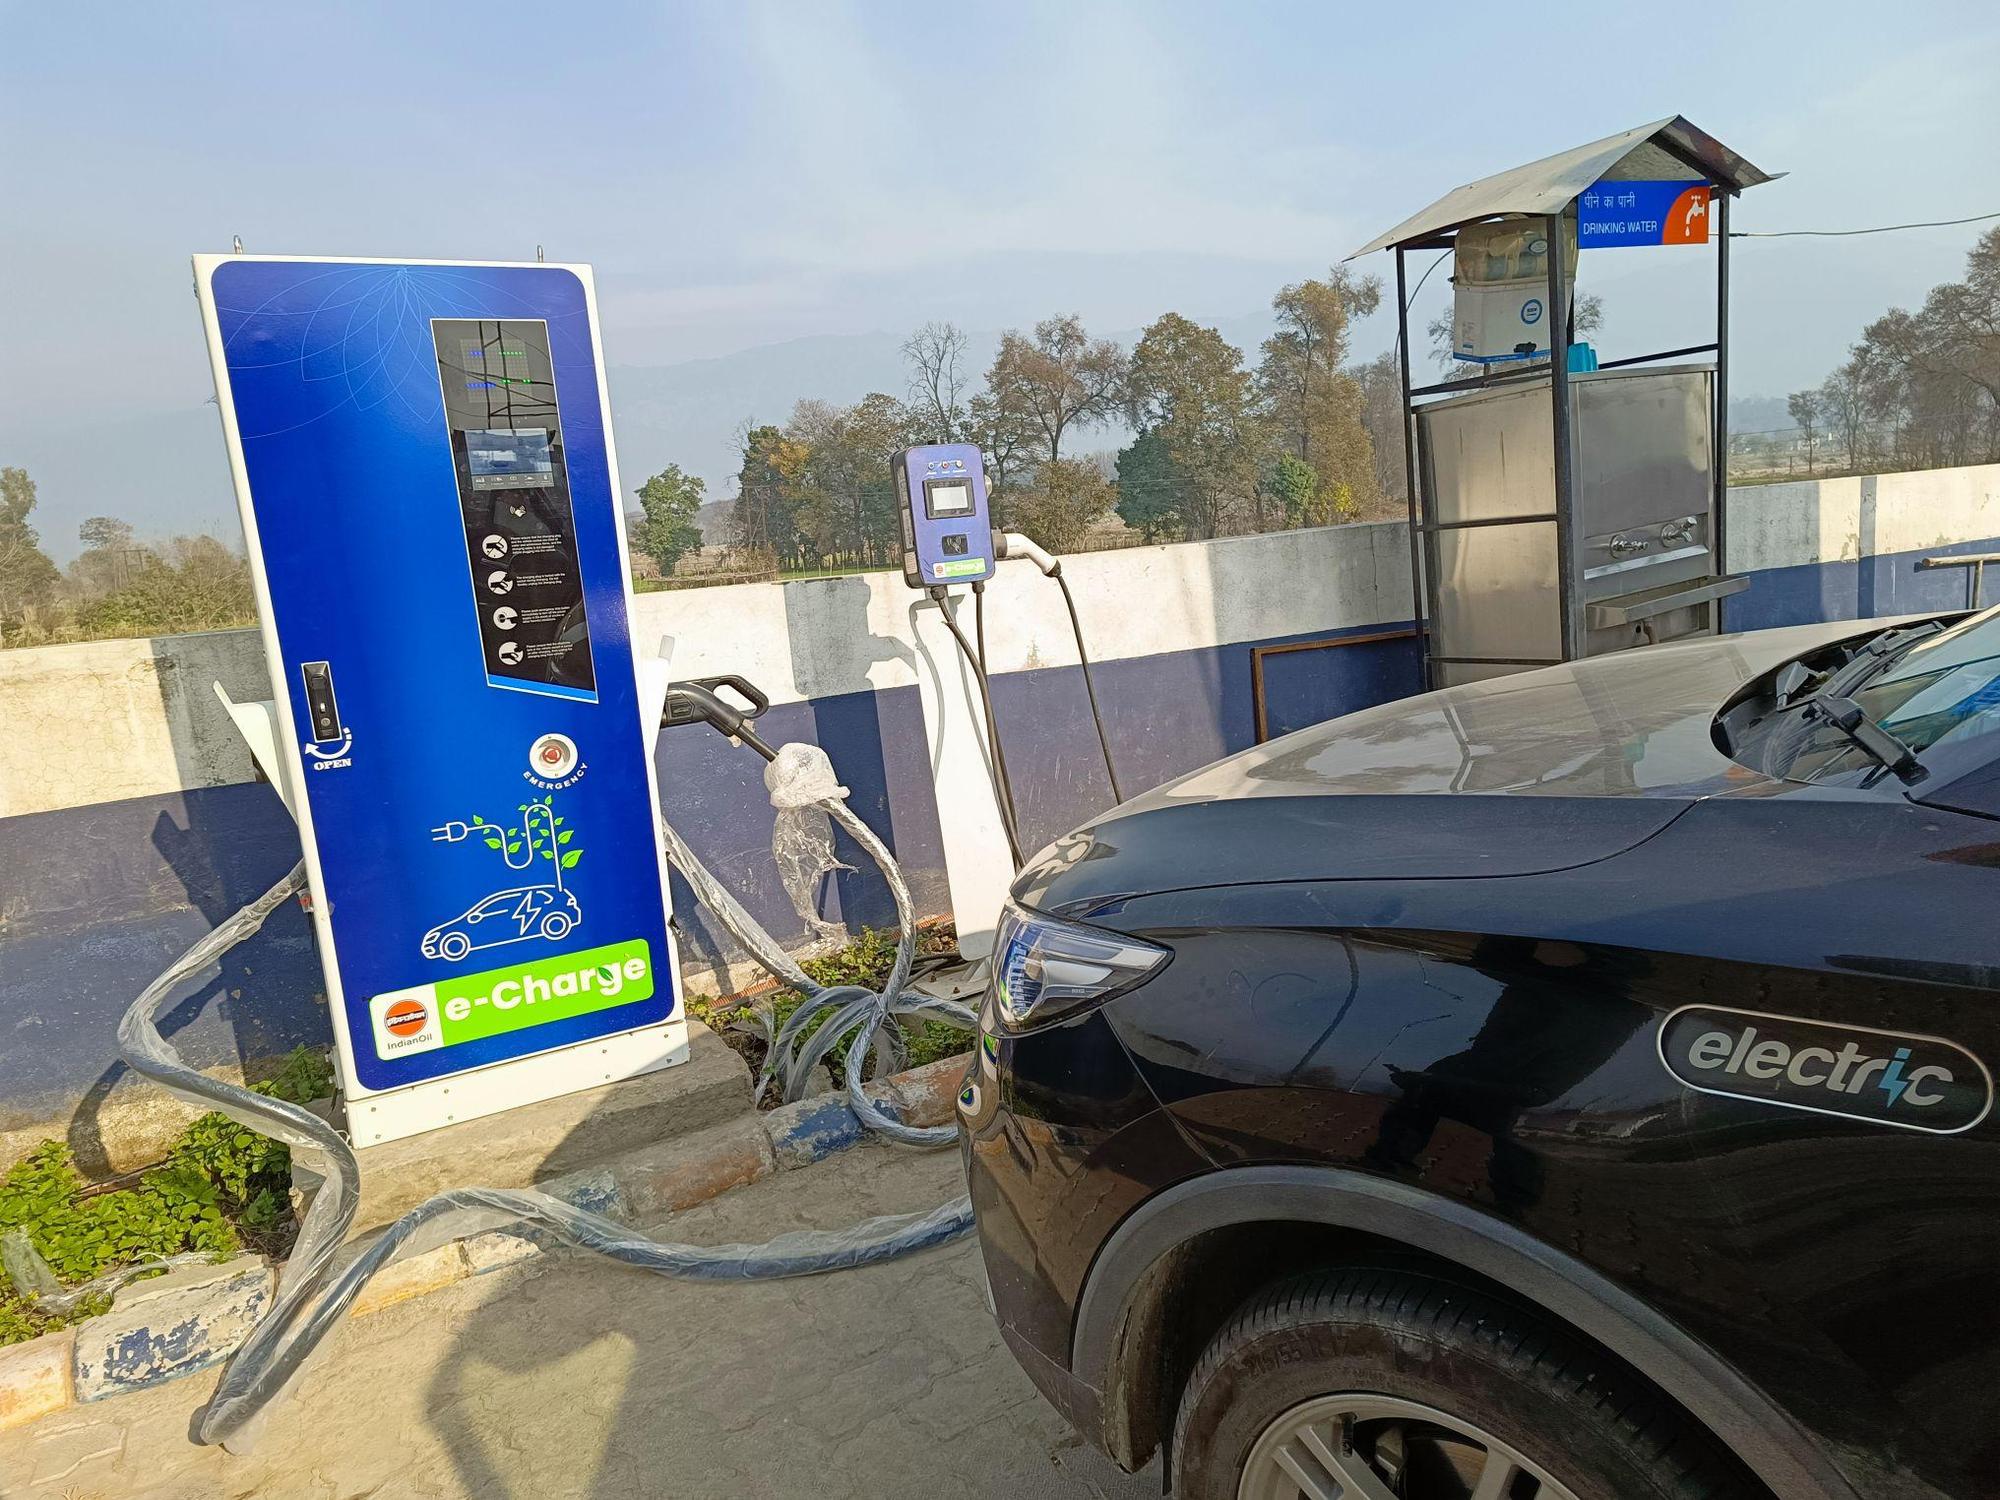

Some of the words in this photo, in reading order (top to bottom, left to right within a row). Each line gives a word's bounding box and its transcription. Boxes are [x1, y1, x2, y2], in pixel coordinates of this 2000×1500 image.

[1584, 192, 1599, 208] पीने
[1604, 195, 1614, 208] का
[1618, 191, 1636, 208] पानी
[1583, 222, 1625, 235] DRINKING
[1627, 220, 1658, 233] WATER
[313, 758, 352, 771] OPEN
[522, 762, 588, 790] EMERGENCY
[444, 957, 647, 1022] e-Charge
[387, 1033, 433, 1050] IndianOil
[1688, 1026, 1954, 1109] electric
